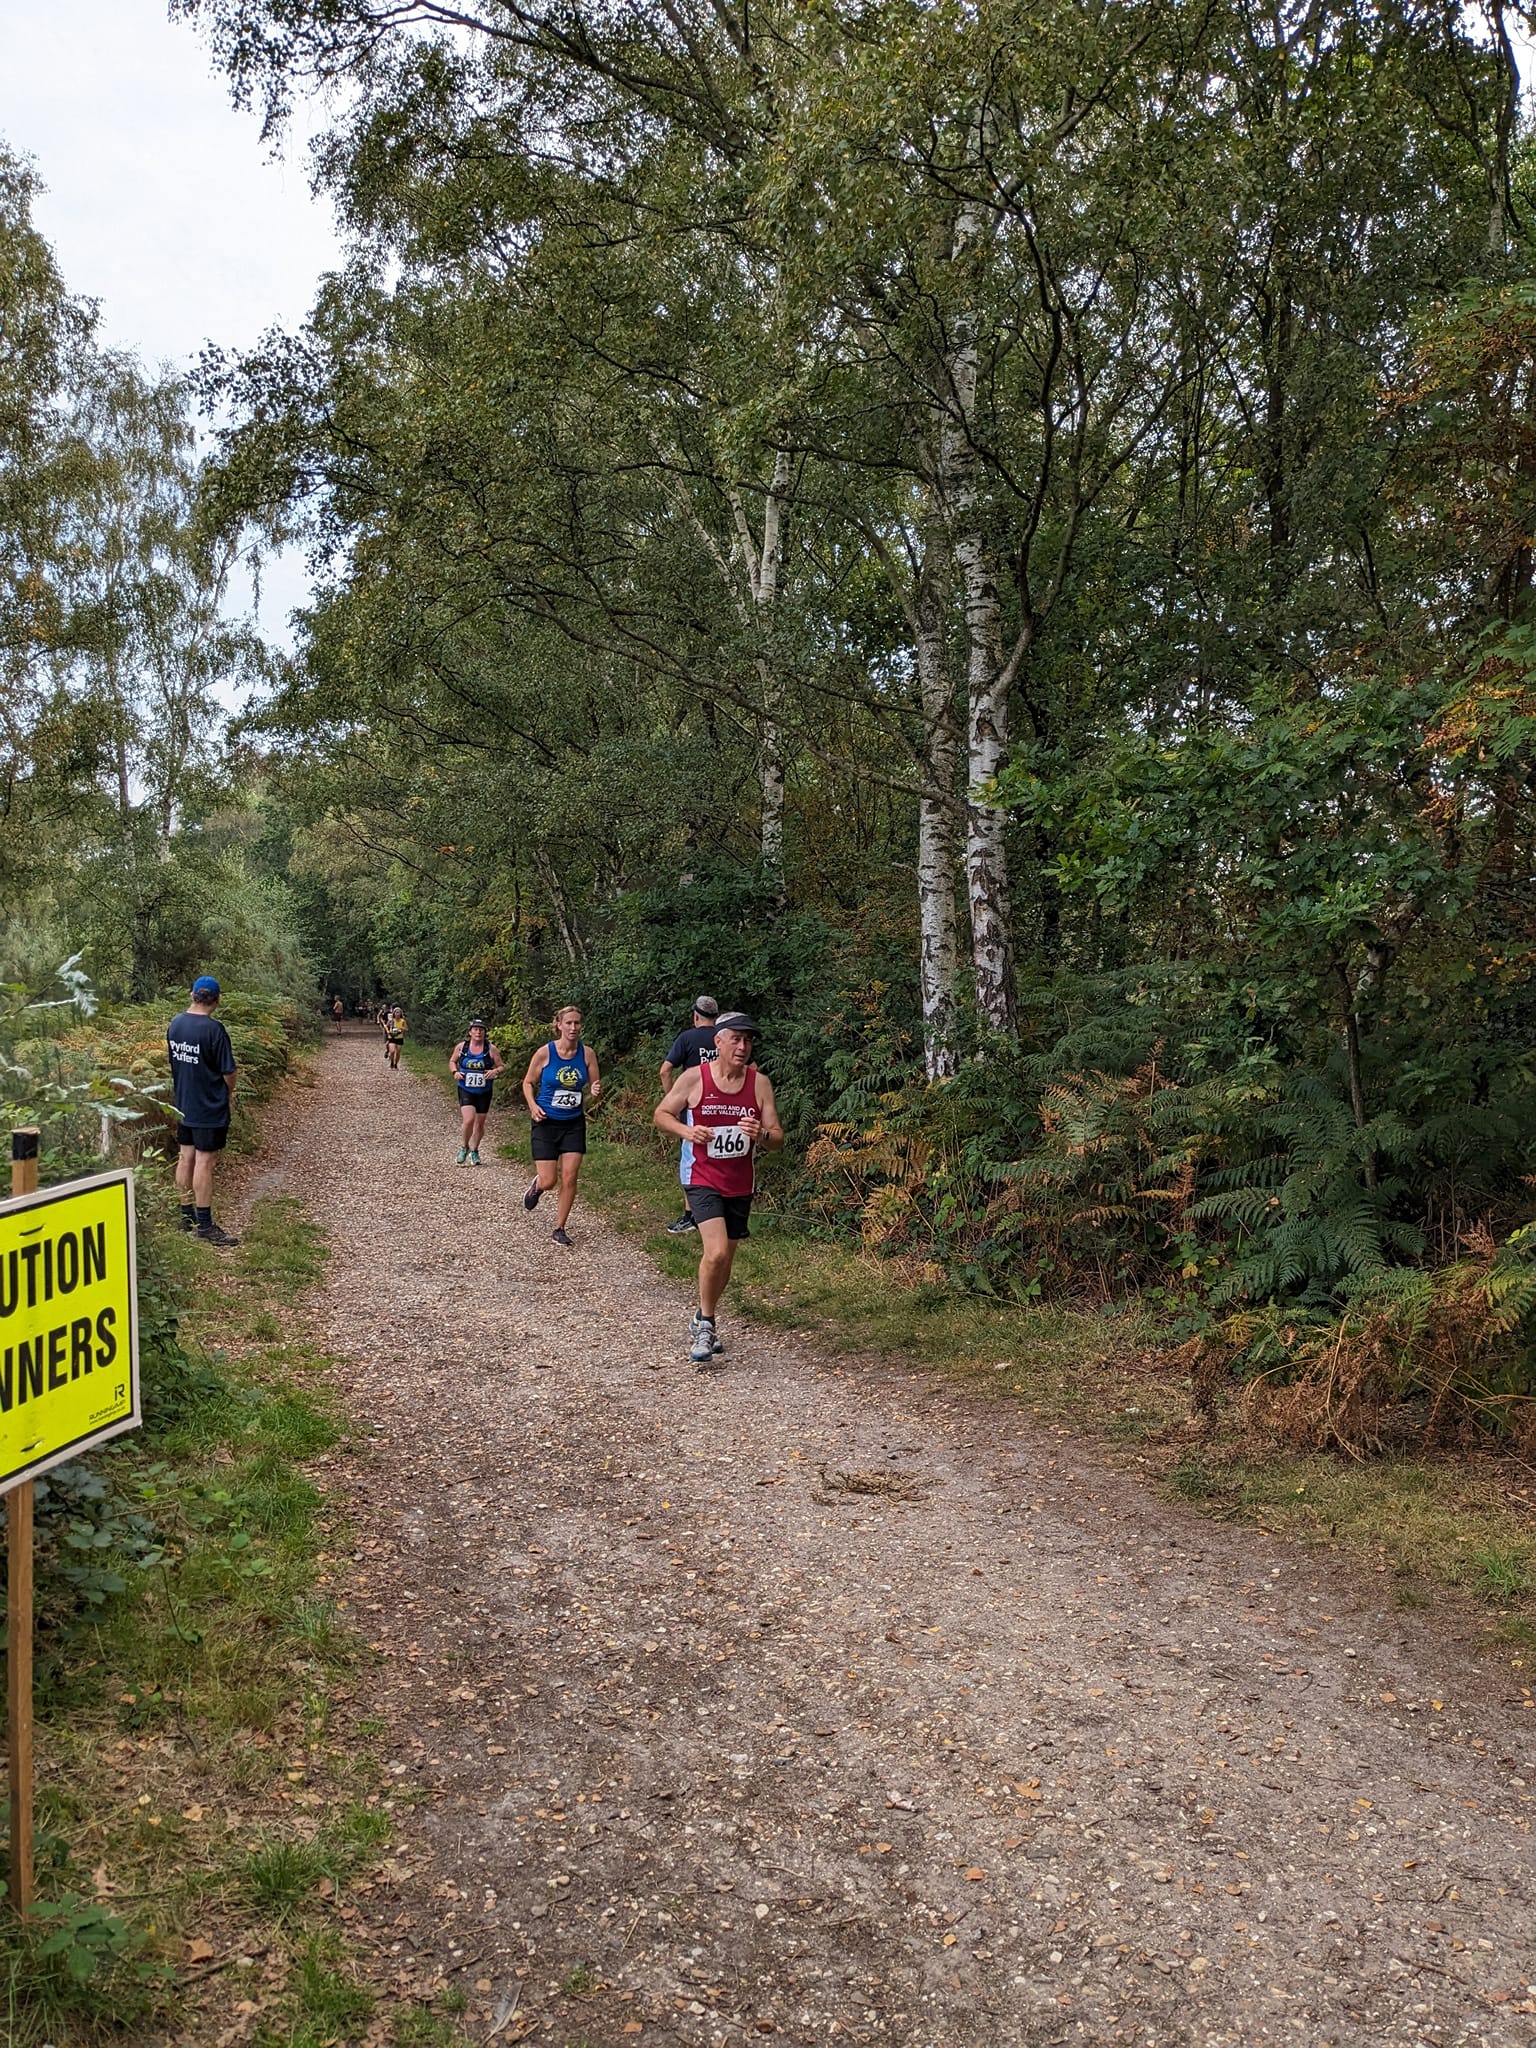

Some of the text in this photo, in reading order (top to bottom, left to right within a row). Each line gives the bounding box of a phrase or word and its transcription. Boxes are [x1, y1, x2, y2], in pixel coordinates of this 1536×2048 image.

[169, 1040, 200, 1054] Pyrford
[468, 1076, 483, 1086] 213
[739, 1106, 756, 1118] AC
[714, 1133, 745, 1154] 466
